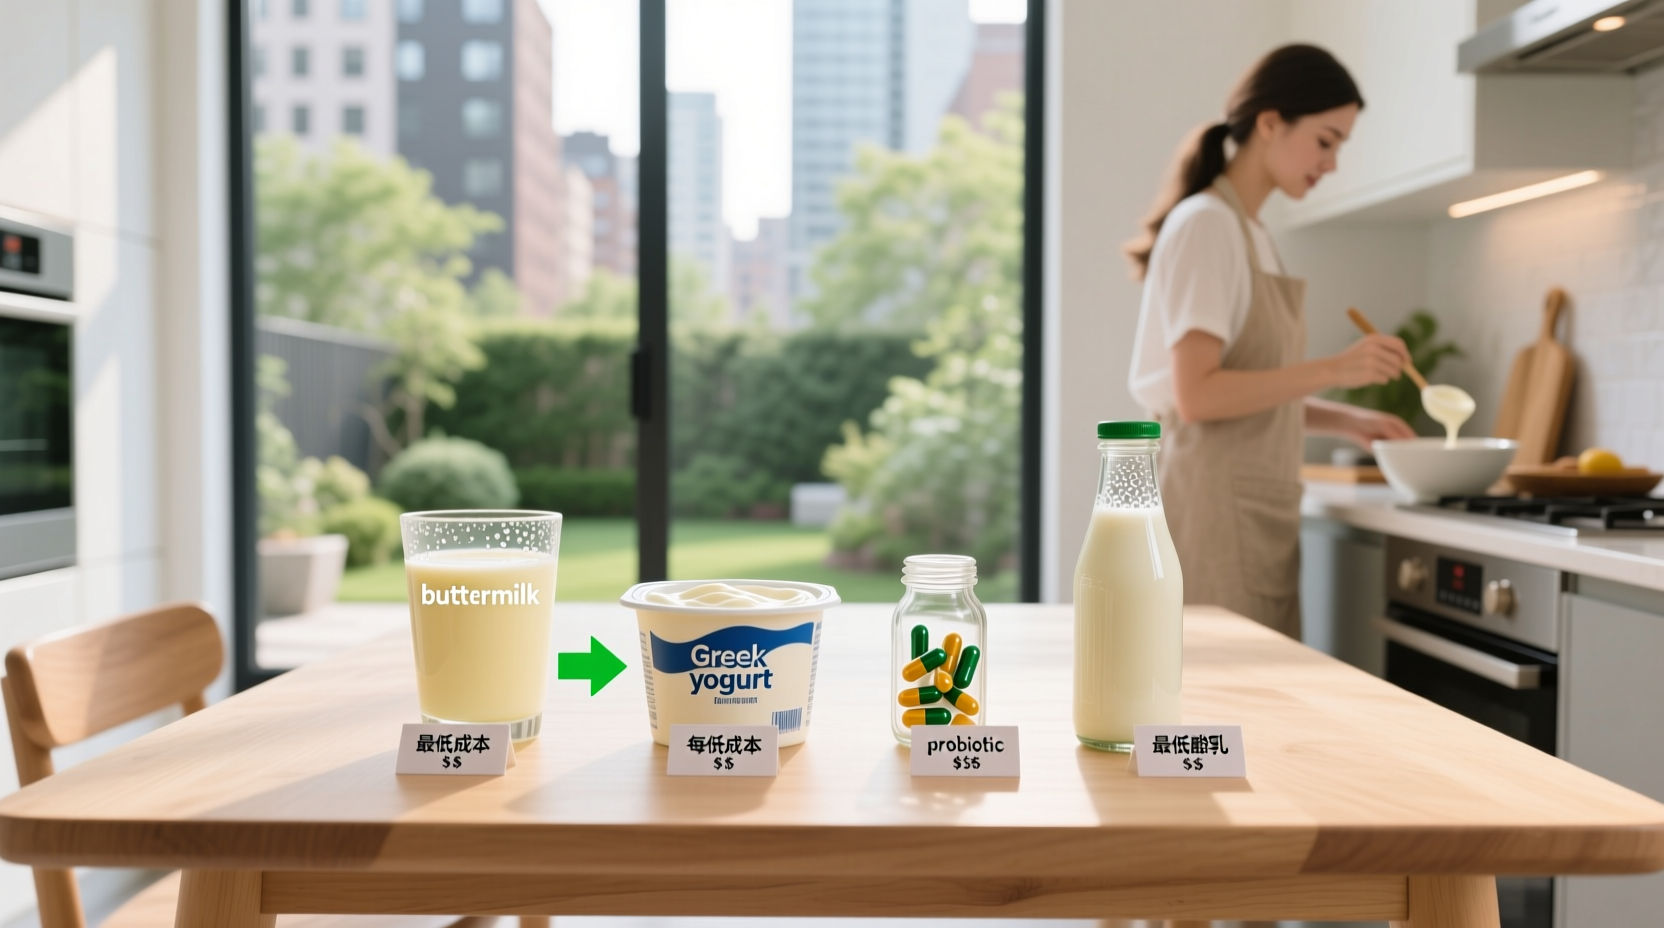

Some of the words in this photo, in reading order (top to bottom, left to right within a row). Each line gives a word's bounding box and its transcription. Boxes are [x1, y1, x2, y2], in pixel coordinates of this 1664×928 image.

[421, 583, 540, 605] buttermilk
[690, 643, 768, 668] Greek
[689, 669, 773, 695] yogurt
[416, 734, 490, 754] 最低成本
[927, 735, 1005, 756] probiotic
